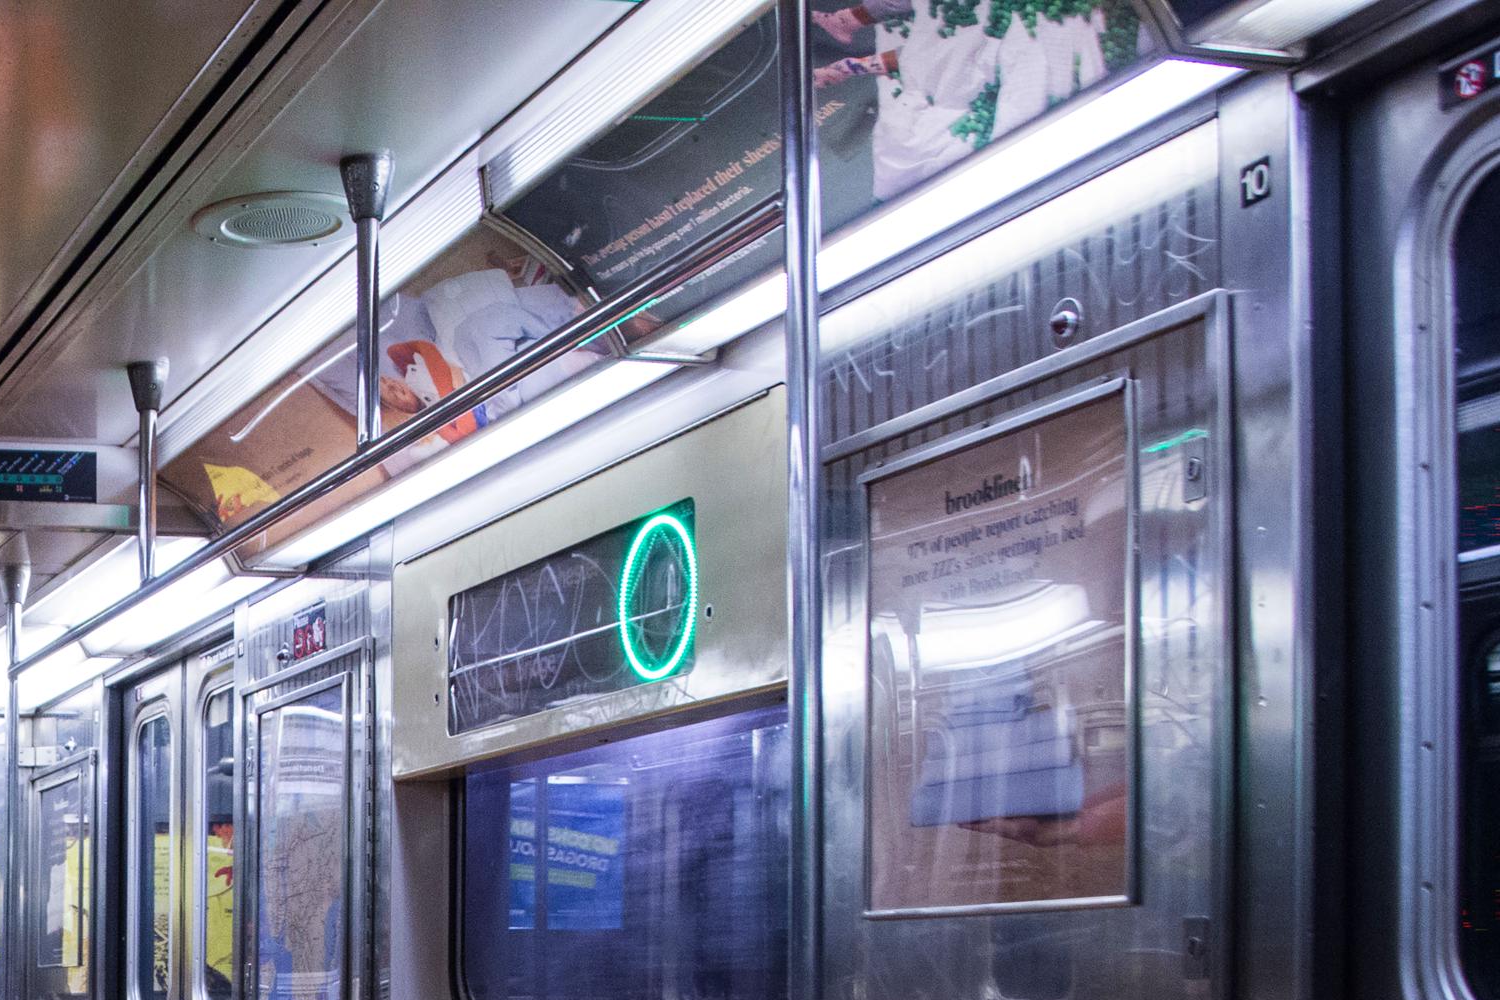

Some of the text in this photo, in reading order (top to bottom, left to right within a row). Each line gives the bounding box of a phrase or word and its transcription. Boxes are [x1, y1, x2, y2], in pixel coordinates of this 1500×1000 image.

[674, 178, 717, 211] replaced
[714, 161, 744, 189] their
[743, 136, 781, 167] sheets
[1241, 163, 1269, 200] 10
[986, 514, 1021, 538] report
[1024, 497, 1079, 526] catching
